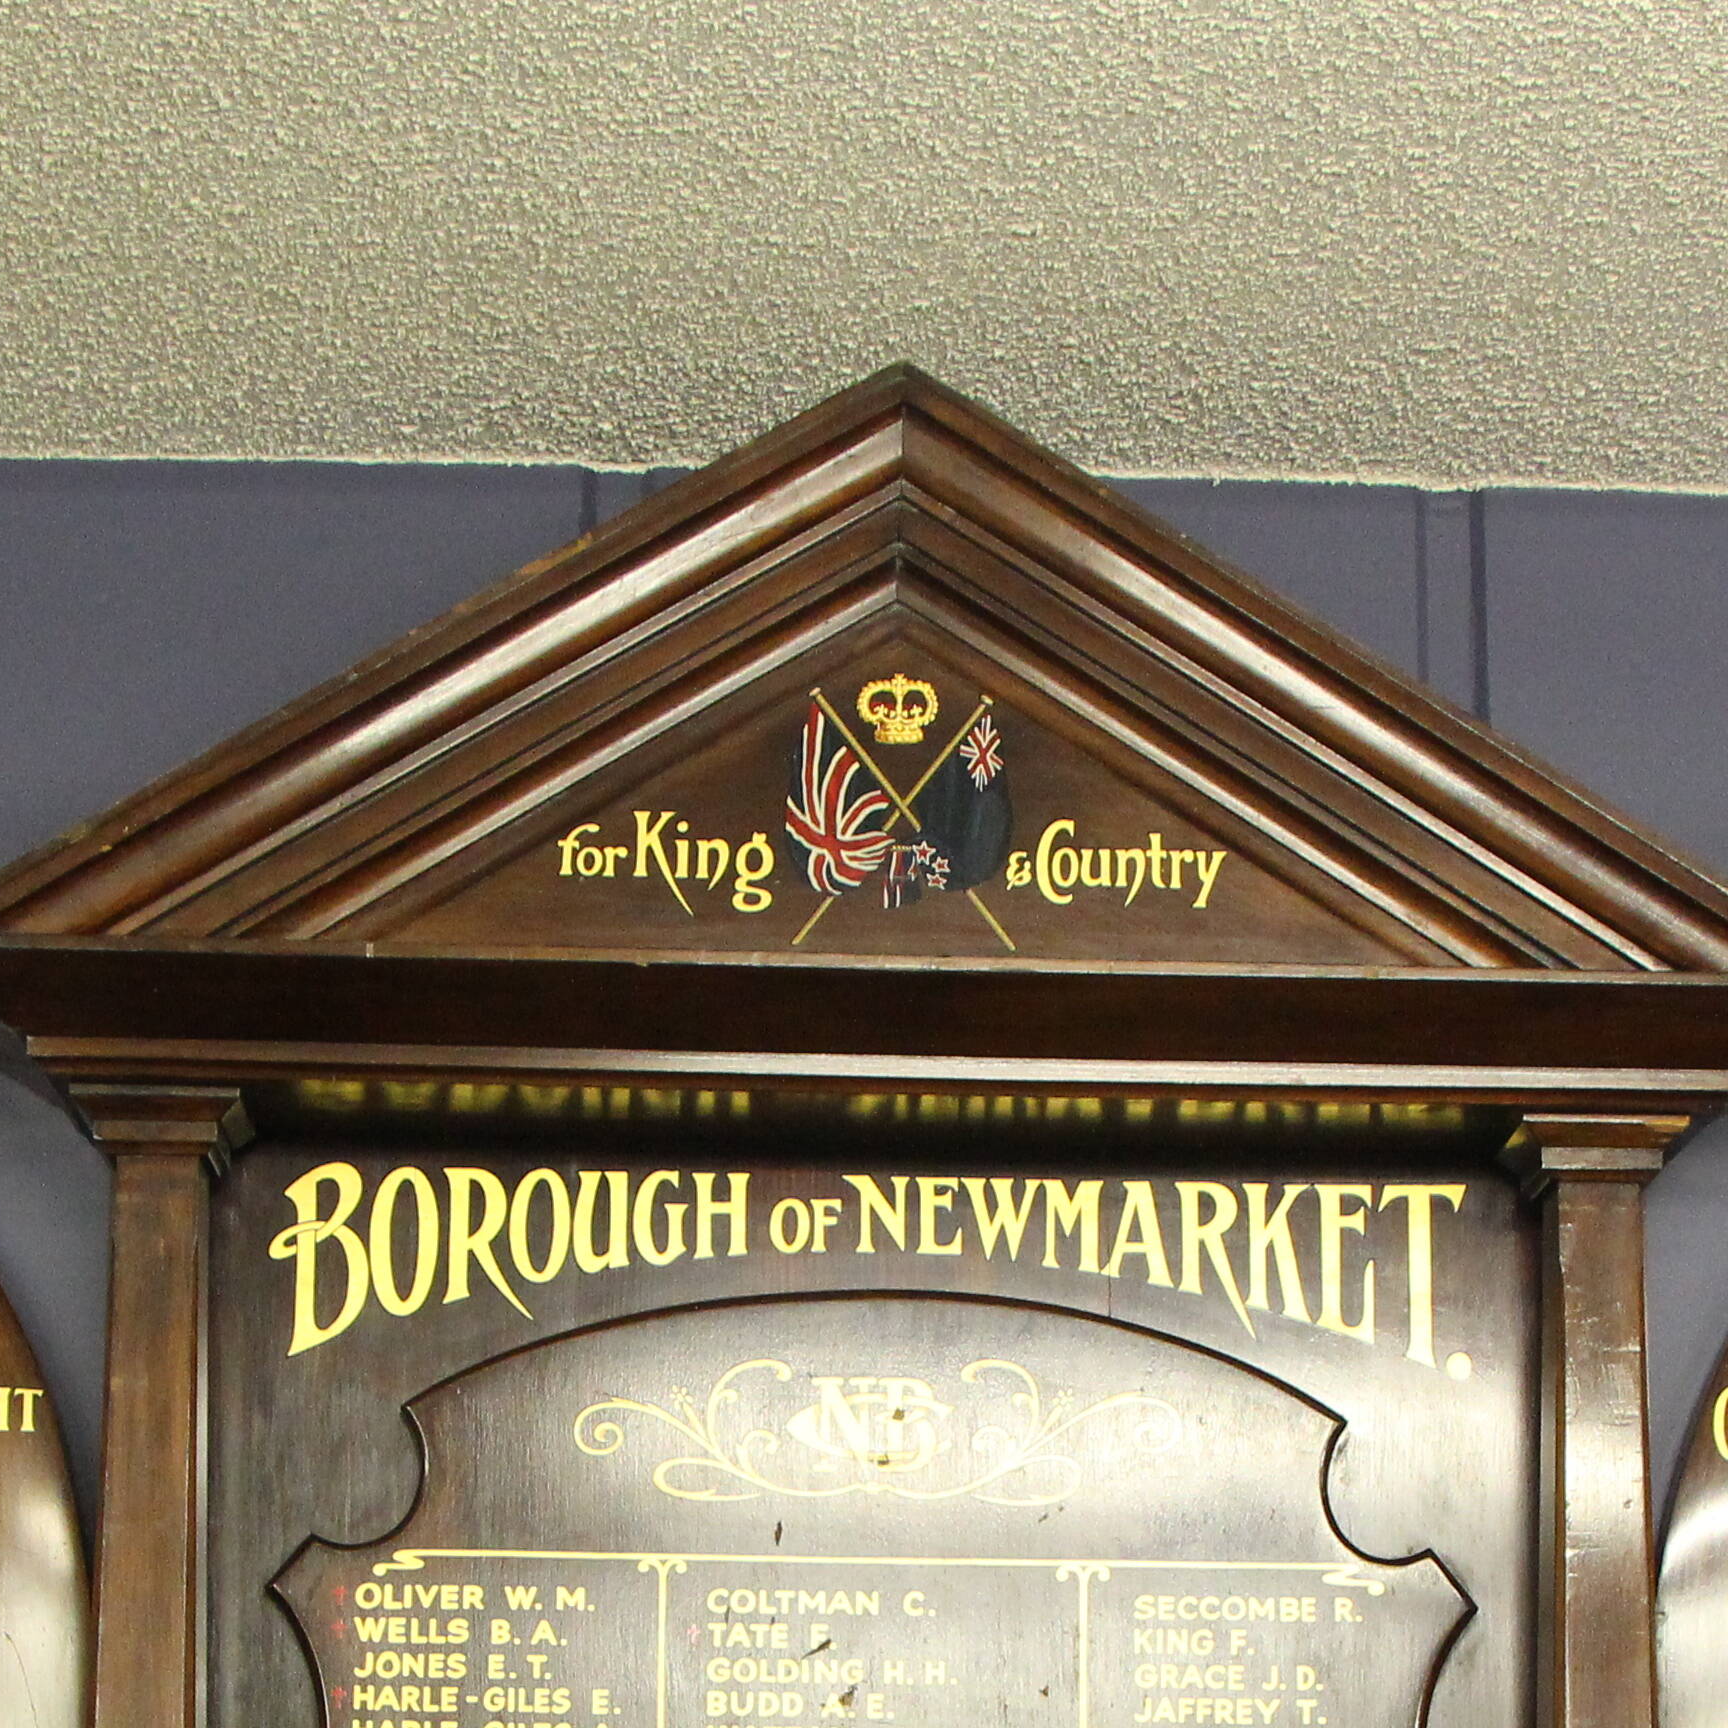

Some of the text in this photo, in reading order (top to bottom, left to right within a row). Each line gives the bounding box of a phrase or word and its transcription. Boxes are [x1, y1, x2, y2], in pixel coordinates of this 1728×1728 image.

[269, 1163, 1467, 1381] BOROUGH OF NEWMARKET.
[1133, 1594, 1363, 1622] SECCOMBE R.
[353, 1685, 571, 1714] HARLE-GILES
